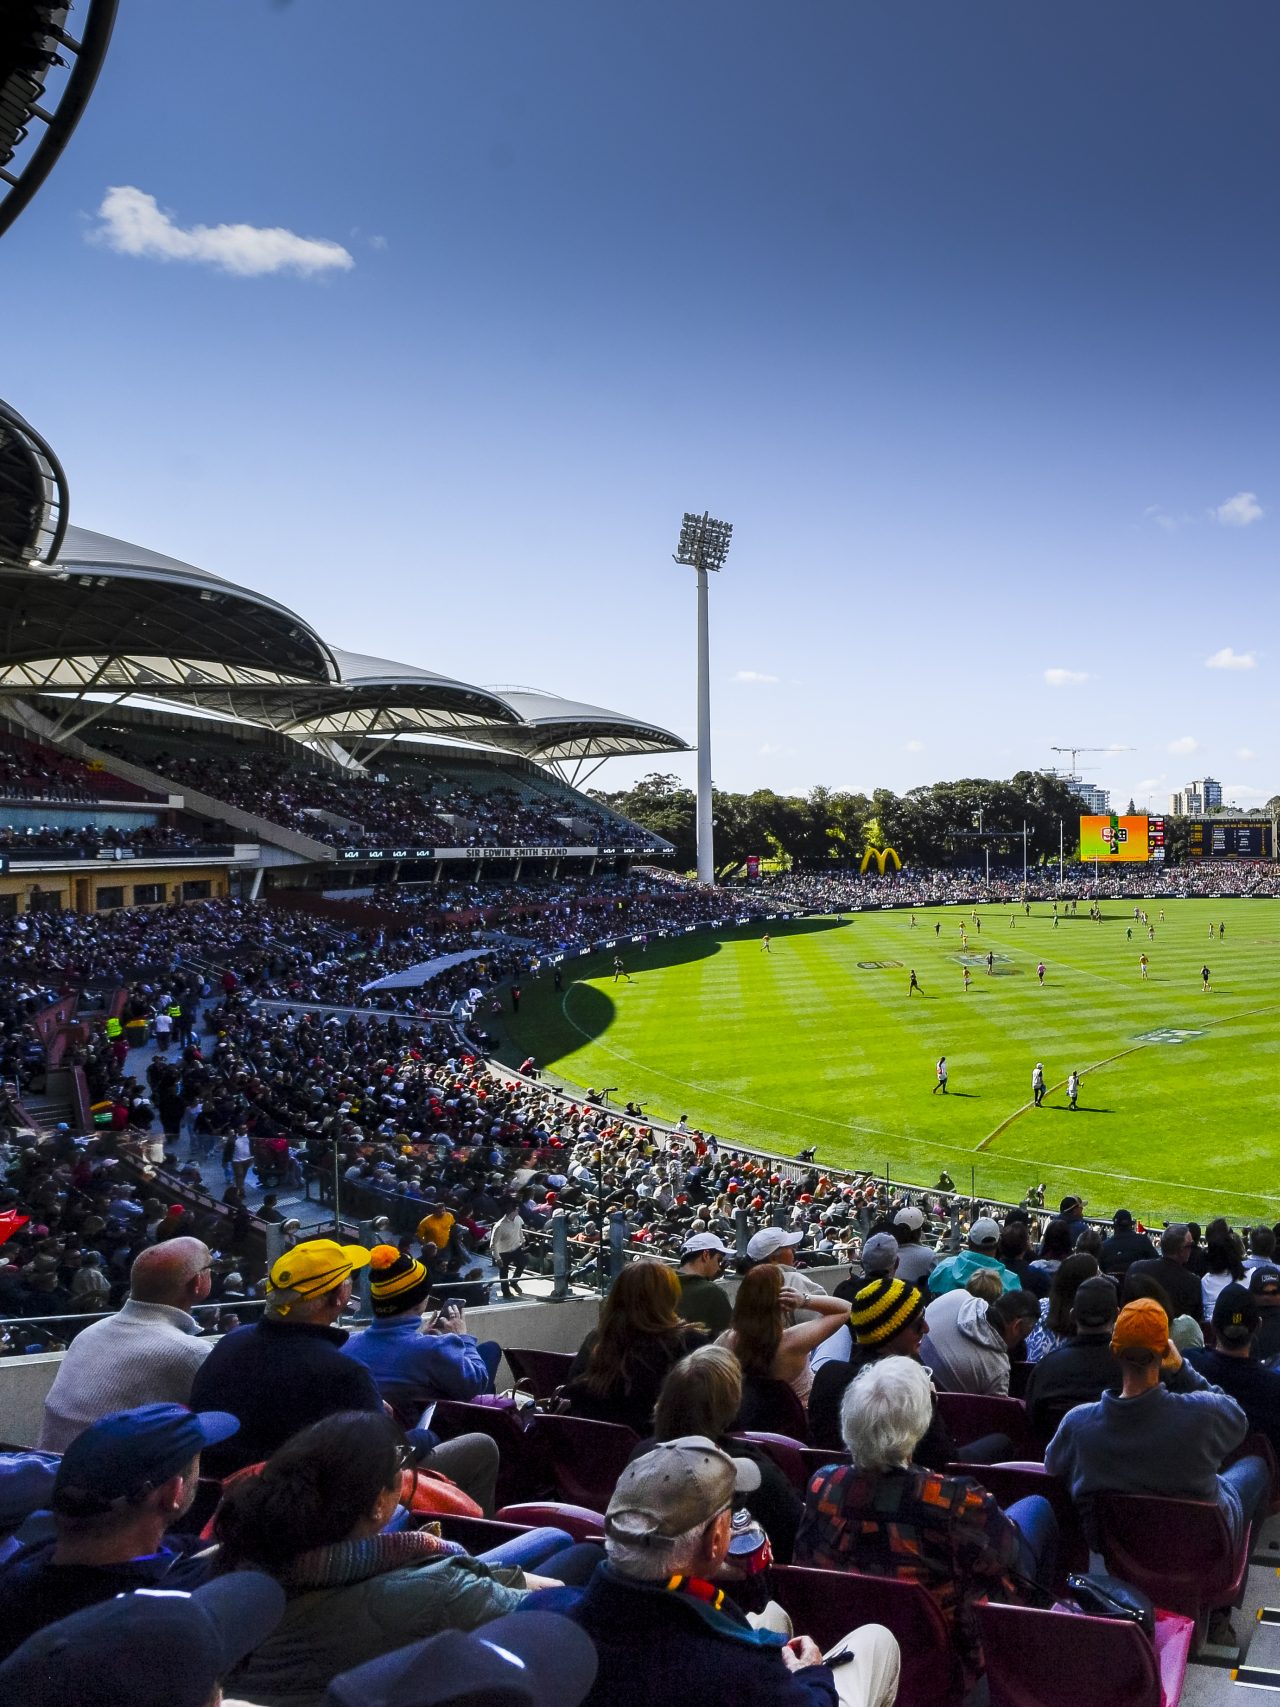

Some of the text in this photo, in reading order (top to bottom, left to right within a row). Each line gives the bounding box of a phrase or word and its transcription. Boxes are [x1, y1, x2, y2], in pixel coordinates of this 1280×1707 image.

[467, 849, 482, 857] SIR
[484, 849, 510, 857] EDWIN
[542, 848, 568, 856] STAND
